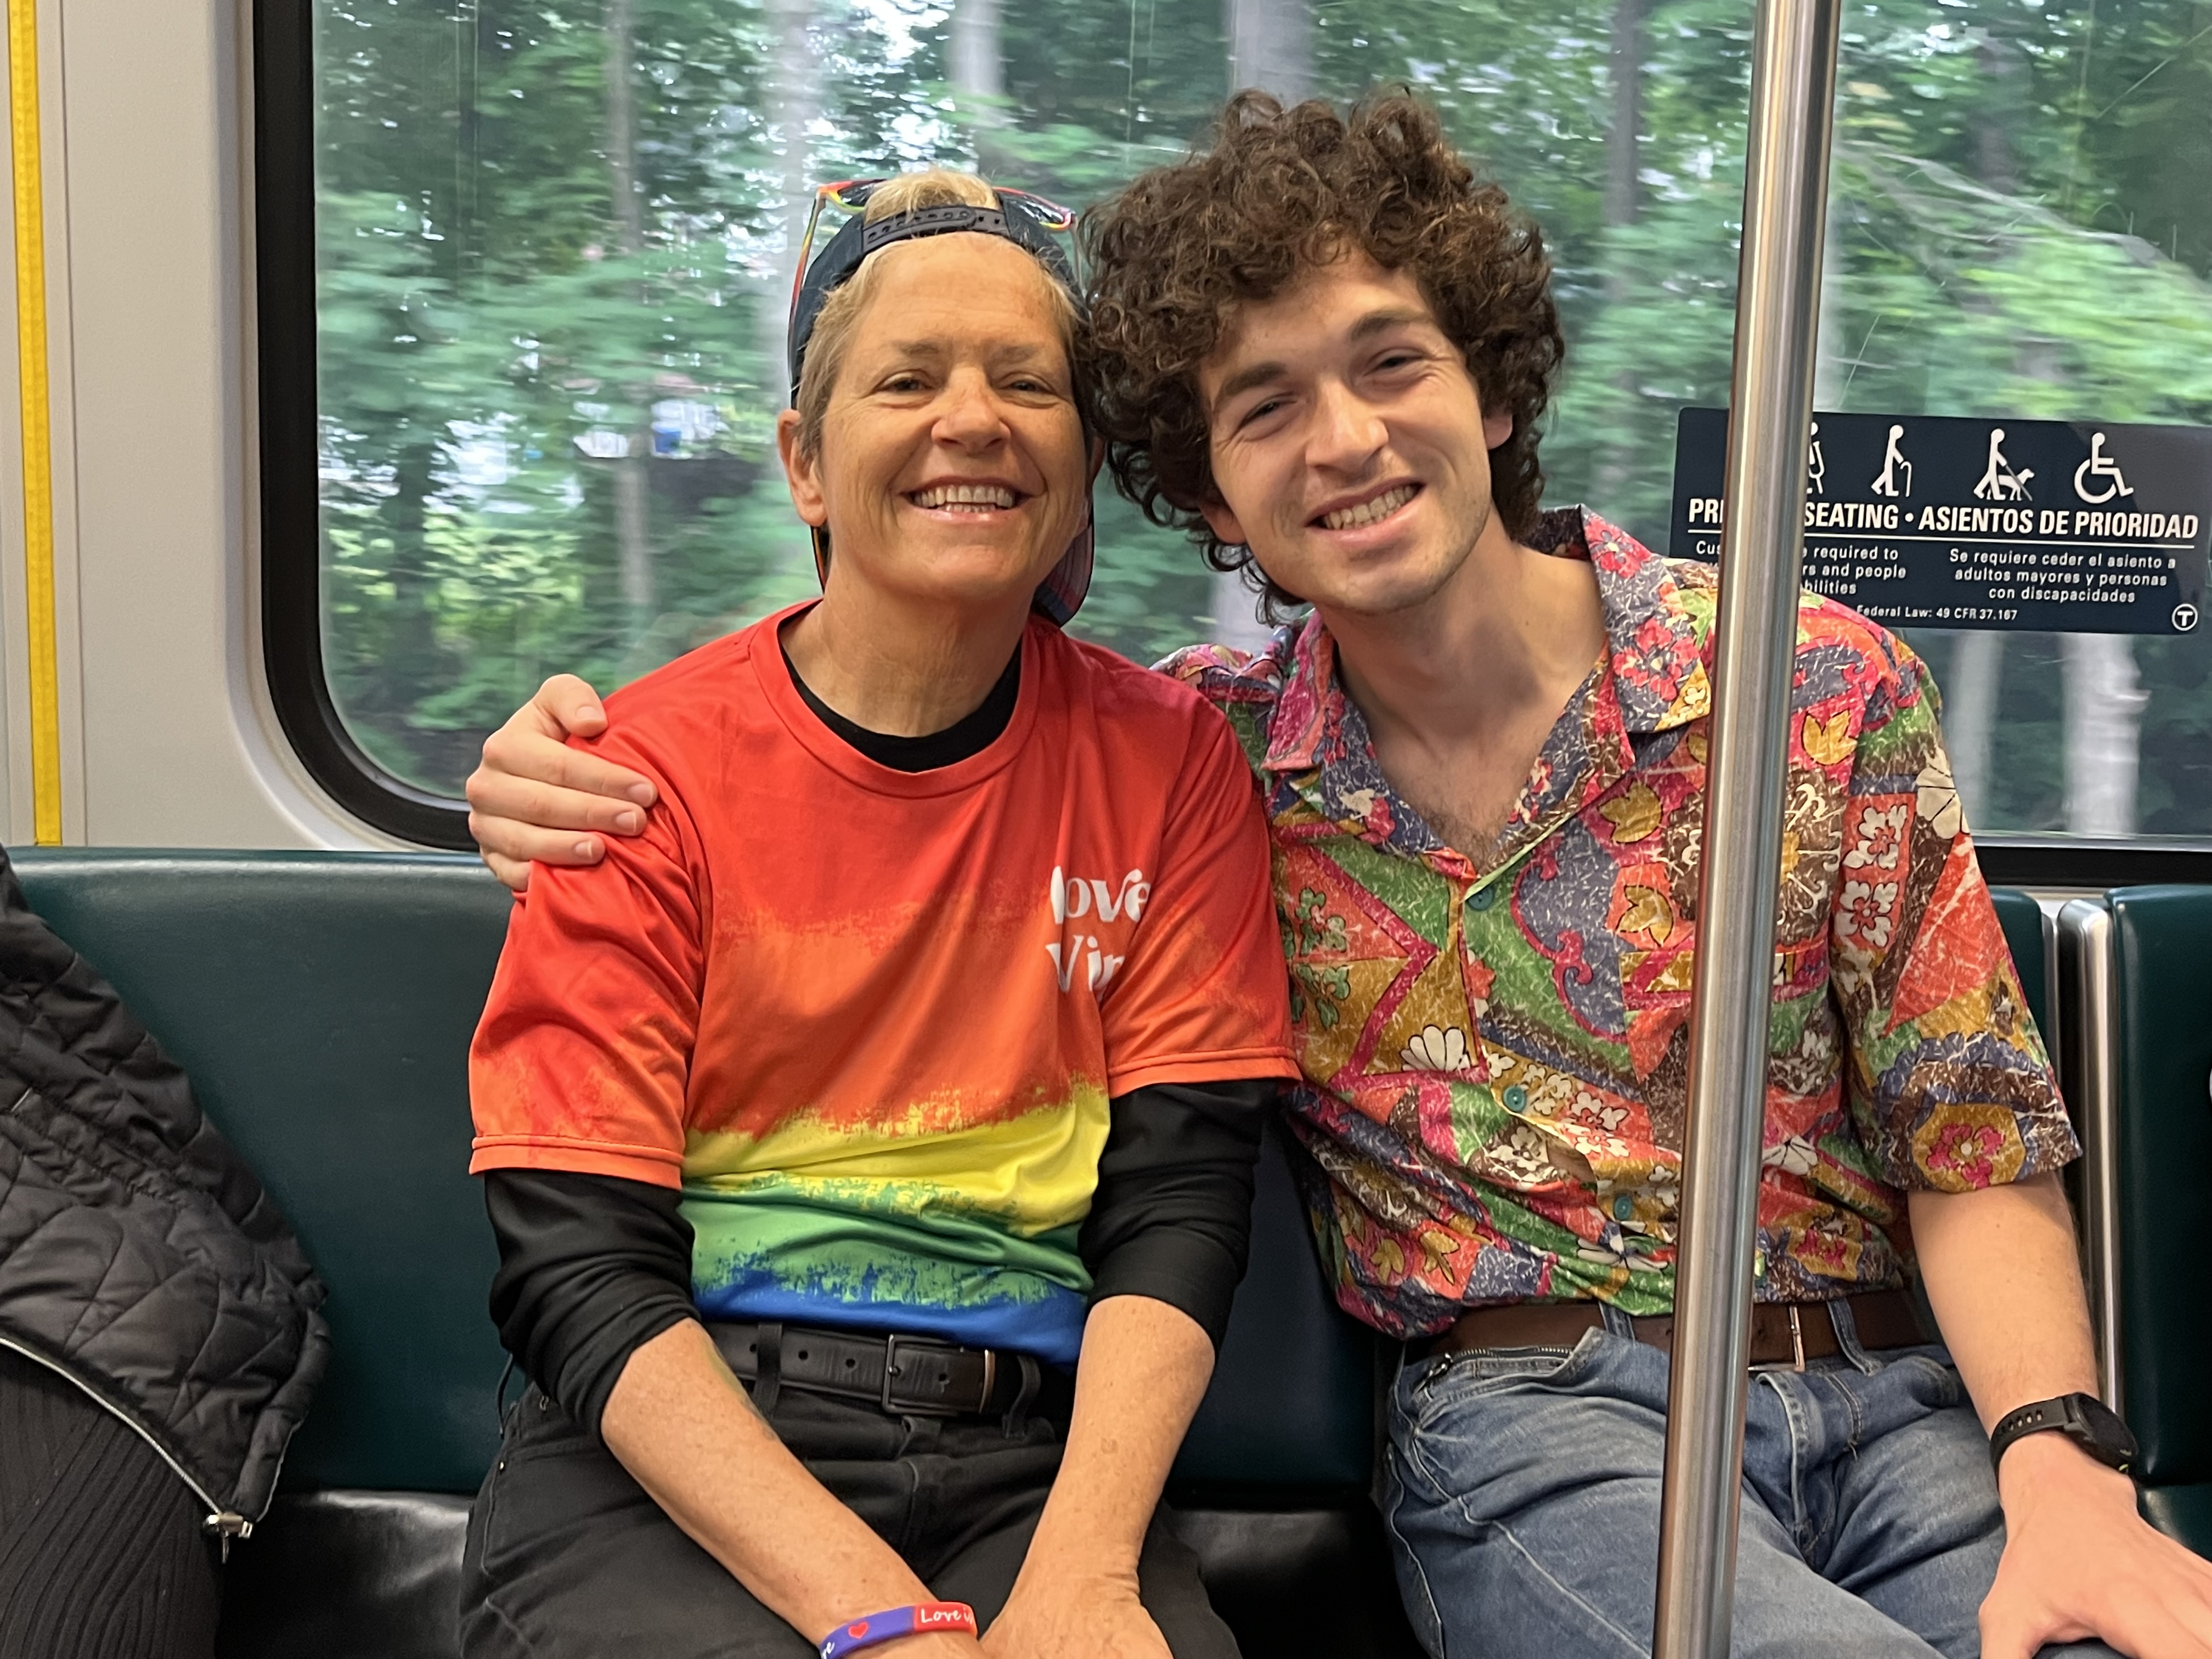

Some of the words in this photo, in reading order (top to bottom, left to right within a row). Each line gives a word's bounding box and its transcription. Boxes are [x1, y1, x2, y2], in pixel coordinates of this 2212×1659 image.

[1804, 502, 1899, 529] SEATING
[1918, 506, 2034, 534] ASIENTOS
[2039, 510, 2070, 535] DE
[2074, 511, 2198, 539] PRIORIDAD
[1814, 545, 1878, 561] required
[1884, 548, 1899, 560] to
[1950, 548, 1968, 562] Se
[1974, 550, 2036, 566] requiere
[2042, 552, 2084, 567] ceder
[2089, 553, 2102, 567] el
[2107, 554, 2162, 569] asiento
[2168, 558, 2176, 569] a
[1822, 563, 1850, 576] and
[1855, 563, 1906, 580] people
[1955, 566, 2011, 582] adultos
[2016, 571, 2080, 585] mayores
[2086, 574, 2094, 586] y
[2099, 574, 2167, 587] personas
[1989, 588, 2016, 599] con
[2021, 586, 2135, 603] discapacidades
[1857, 605, 1901, 617] Federal
[1905, 607, 1932, 618] Law:
[1954, 608, 1976, 619] CFR
[921, 1608, 962, 1623] Love
